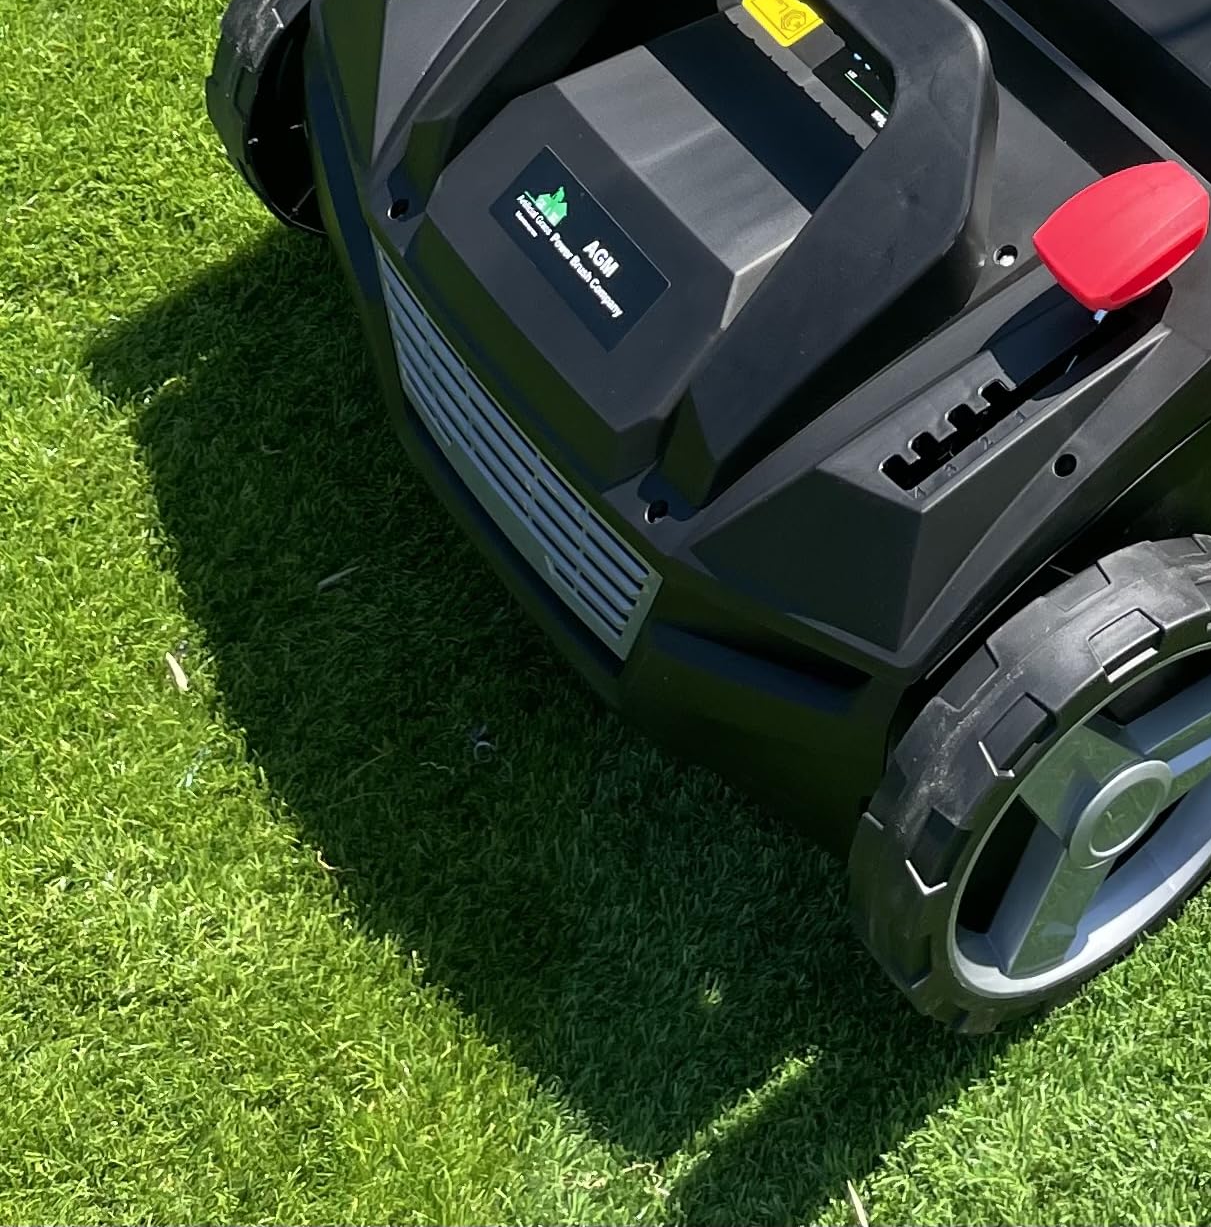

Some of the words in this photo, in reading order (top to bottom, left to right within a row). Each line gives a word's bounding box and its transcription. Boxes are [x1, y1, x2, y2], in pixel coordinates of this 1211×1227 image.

[550, 233, 574, 259] Power
[569, 255, 592, 282] Brush
[590, 278, 623, 318] Company
[582, 240, 619, 278] AGM
[943, 463, 959, 477] 3
[977, 436, 994, 451] 2
